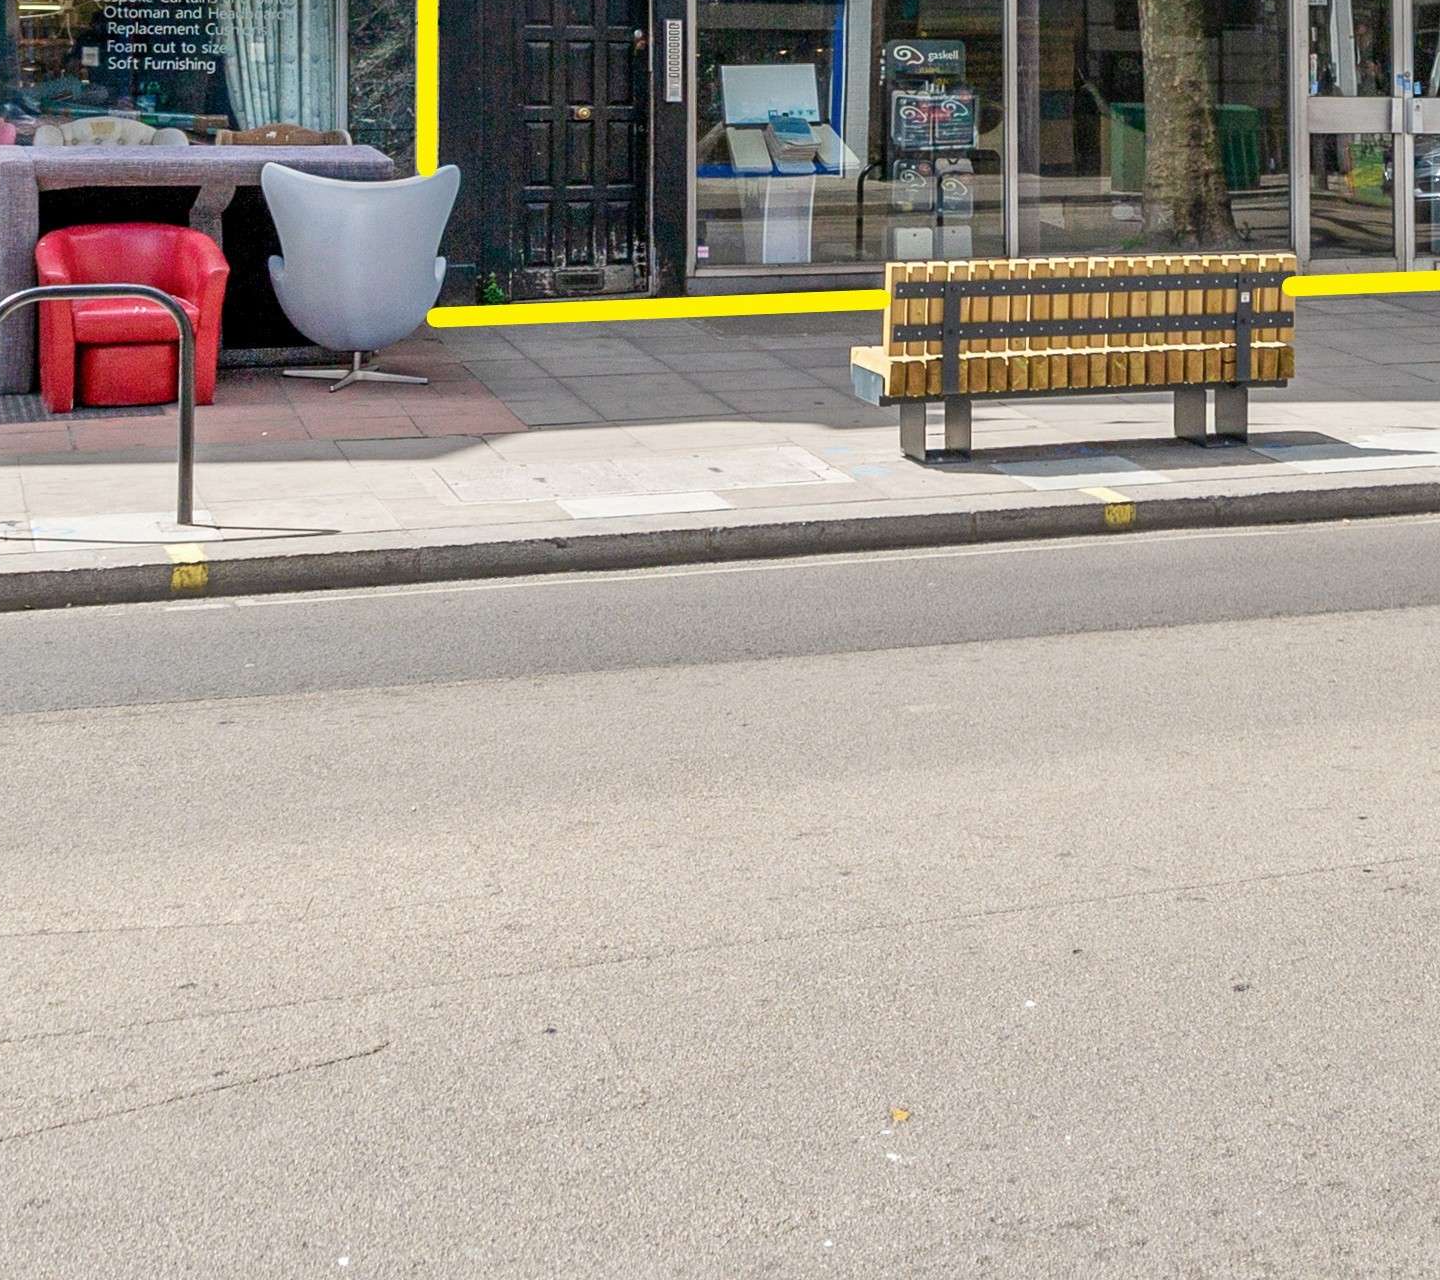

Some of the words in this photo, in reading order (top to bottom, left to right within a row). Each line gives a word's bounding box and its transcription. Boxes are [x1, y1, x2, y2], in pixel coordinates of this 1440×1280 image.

[104, 6, 170, 20] Ottoman
[175, 6, 203, 20] and
[107, 22, 200, 37] Replacement
[107, 40, 147, 54] Foam
[153, 41, 177, 54] cut
[181, 41, 197, 54] to
[201, 41, 226, 55] size
[927, 50, 959, 62] gaskell
[108, 56, 139, 71] Soft
[144, 57, 216, 73] Furnishing
